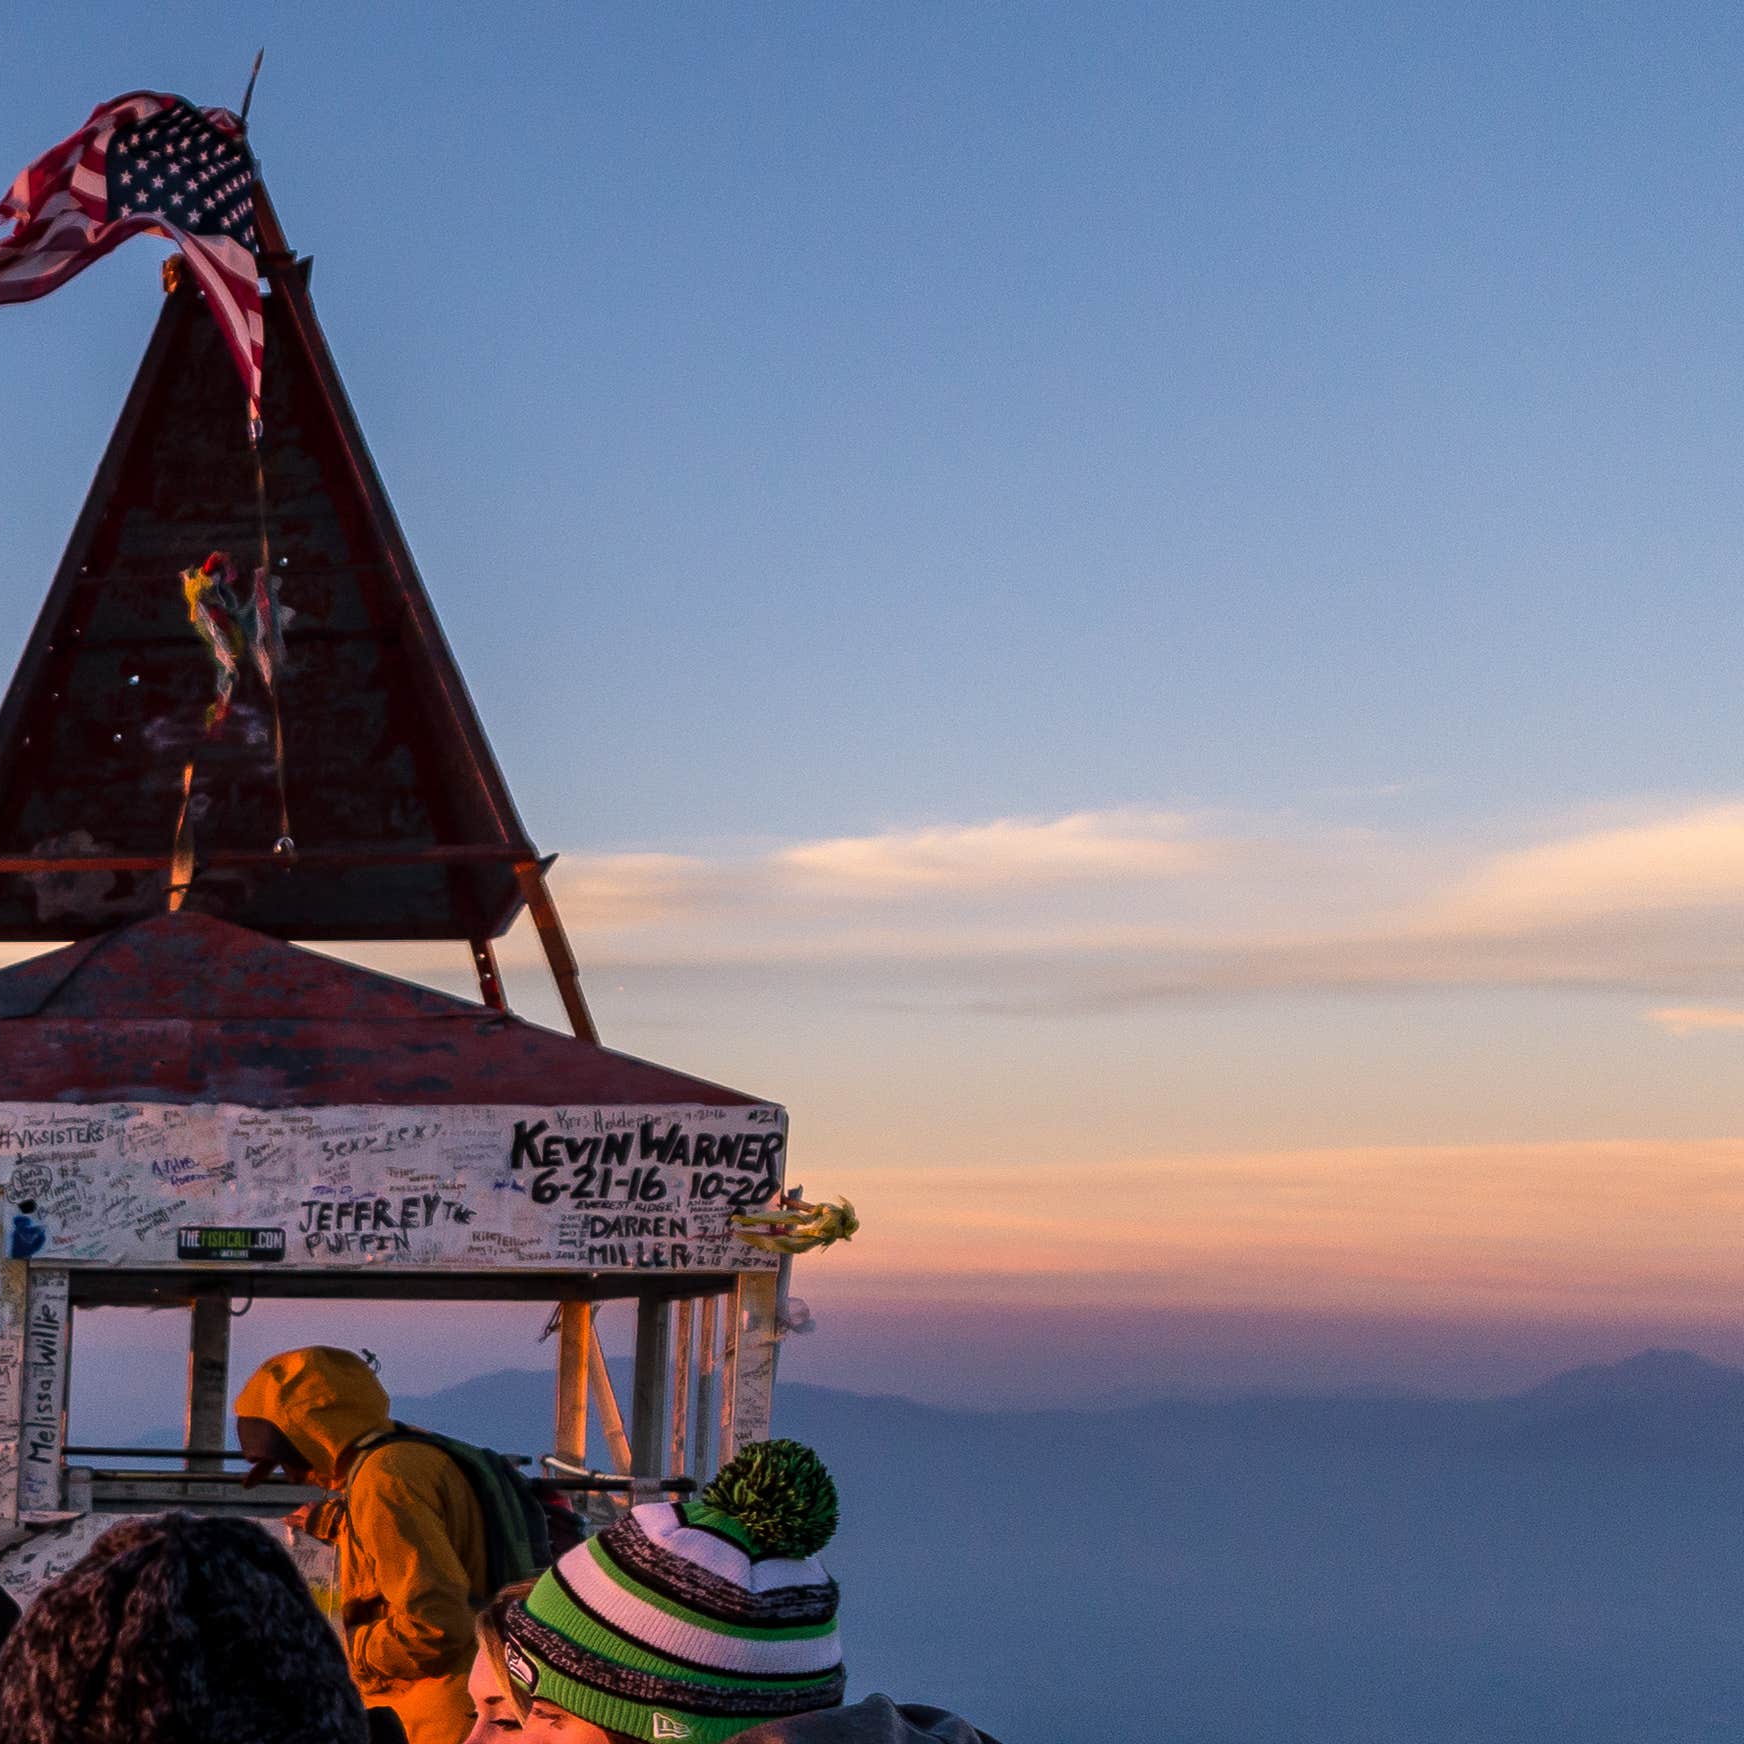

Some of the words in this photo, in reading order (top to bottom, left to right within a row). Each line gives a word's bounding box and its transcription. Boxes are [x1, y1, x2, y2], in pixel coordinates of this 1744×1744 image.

[510, 1118, 635, 1169] KEVIN
[640, 1121, 783, 1175] WARNER
[531, 1164, 667, 1204] 6-21-16
[299, 1192, 442, 1232] JEFFREY
[590, 1215, 687, 1239] DARREN
[305, 1230, 411, 1257] PUFFIN
[588, 1241, 690, 1268] MILLER
[25, 1379, 56, 1464] Melissa
